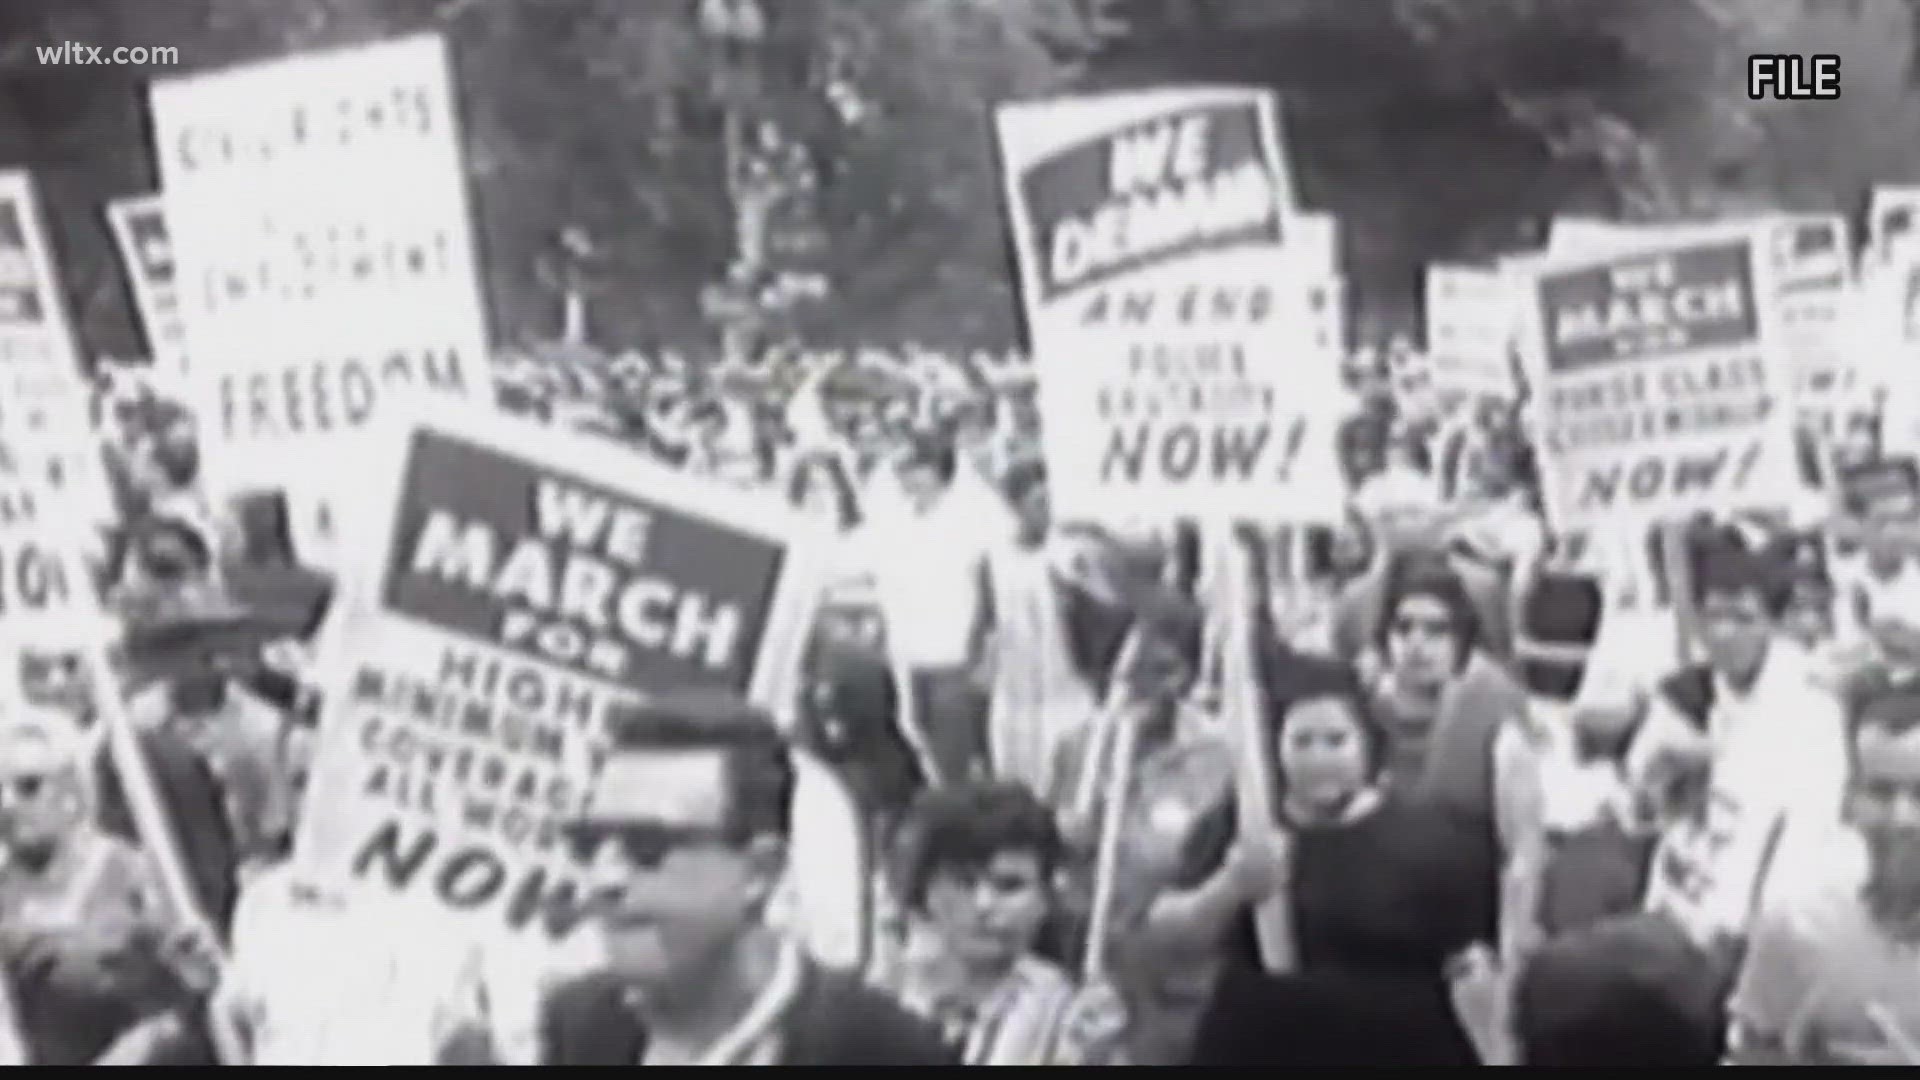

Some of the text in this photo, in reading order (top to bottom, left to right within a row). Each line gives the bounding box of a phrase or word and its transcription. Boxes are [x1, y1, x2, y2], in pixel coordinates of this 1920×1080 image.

[1112, 116, 1206, 194] WE
[1080, 288, 1158, 328] AN
[1174, 283, 1273, 327] END
[1557, 279, 1742, 345] MARCH
[217, 345, 470, 442] FREEDOM
[1098, 413, 1308, 486] NOW!
[1577, 438, 1765, 512] NOW!
[535, 476, 653, 567] WE
[409, 508, 744, 670] MARCH
[500, 608, 630, 678] FOR
[350, 660, 567, 766] MINIMUM
[437, 642, 596, 734] HIGH
[363, 761, 560, 856] ALL WOR
